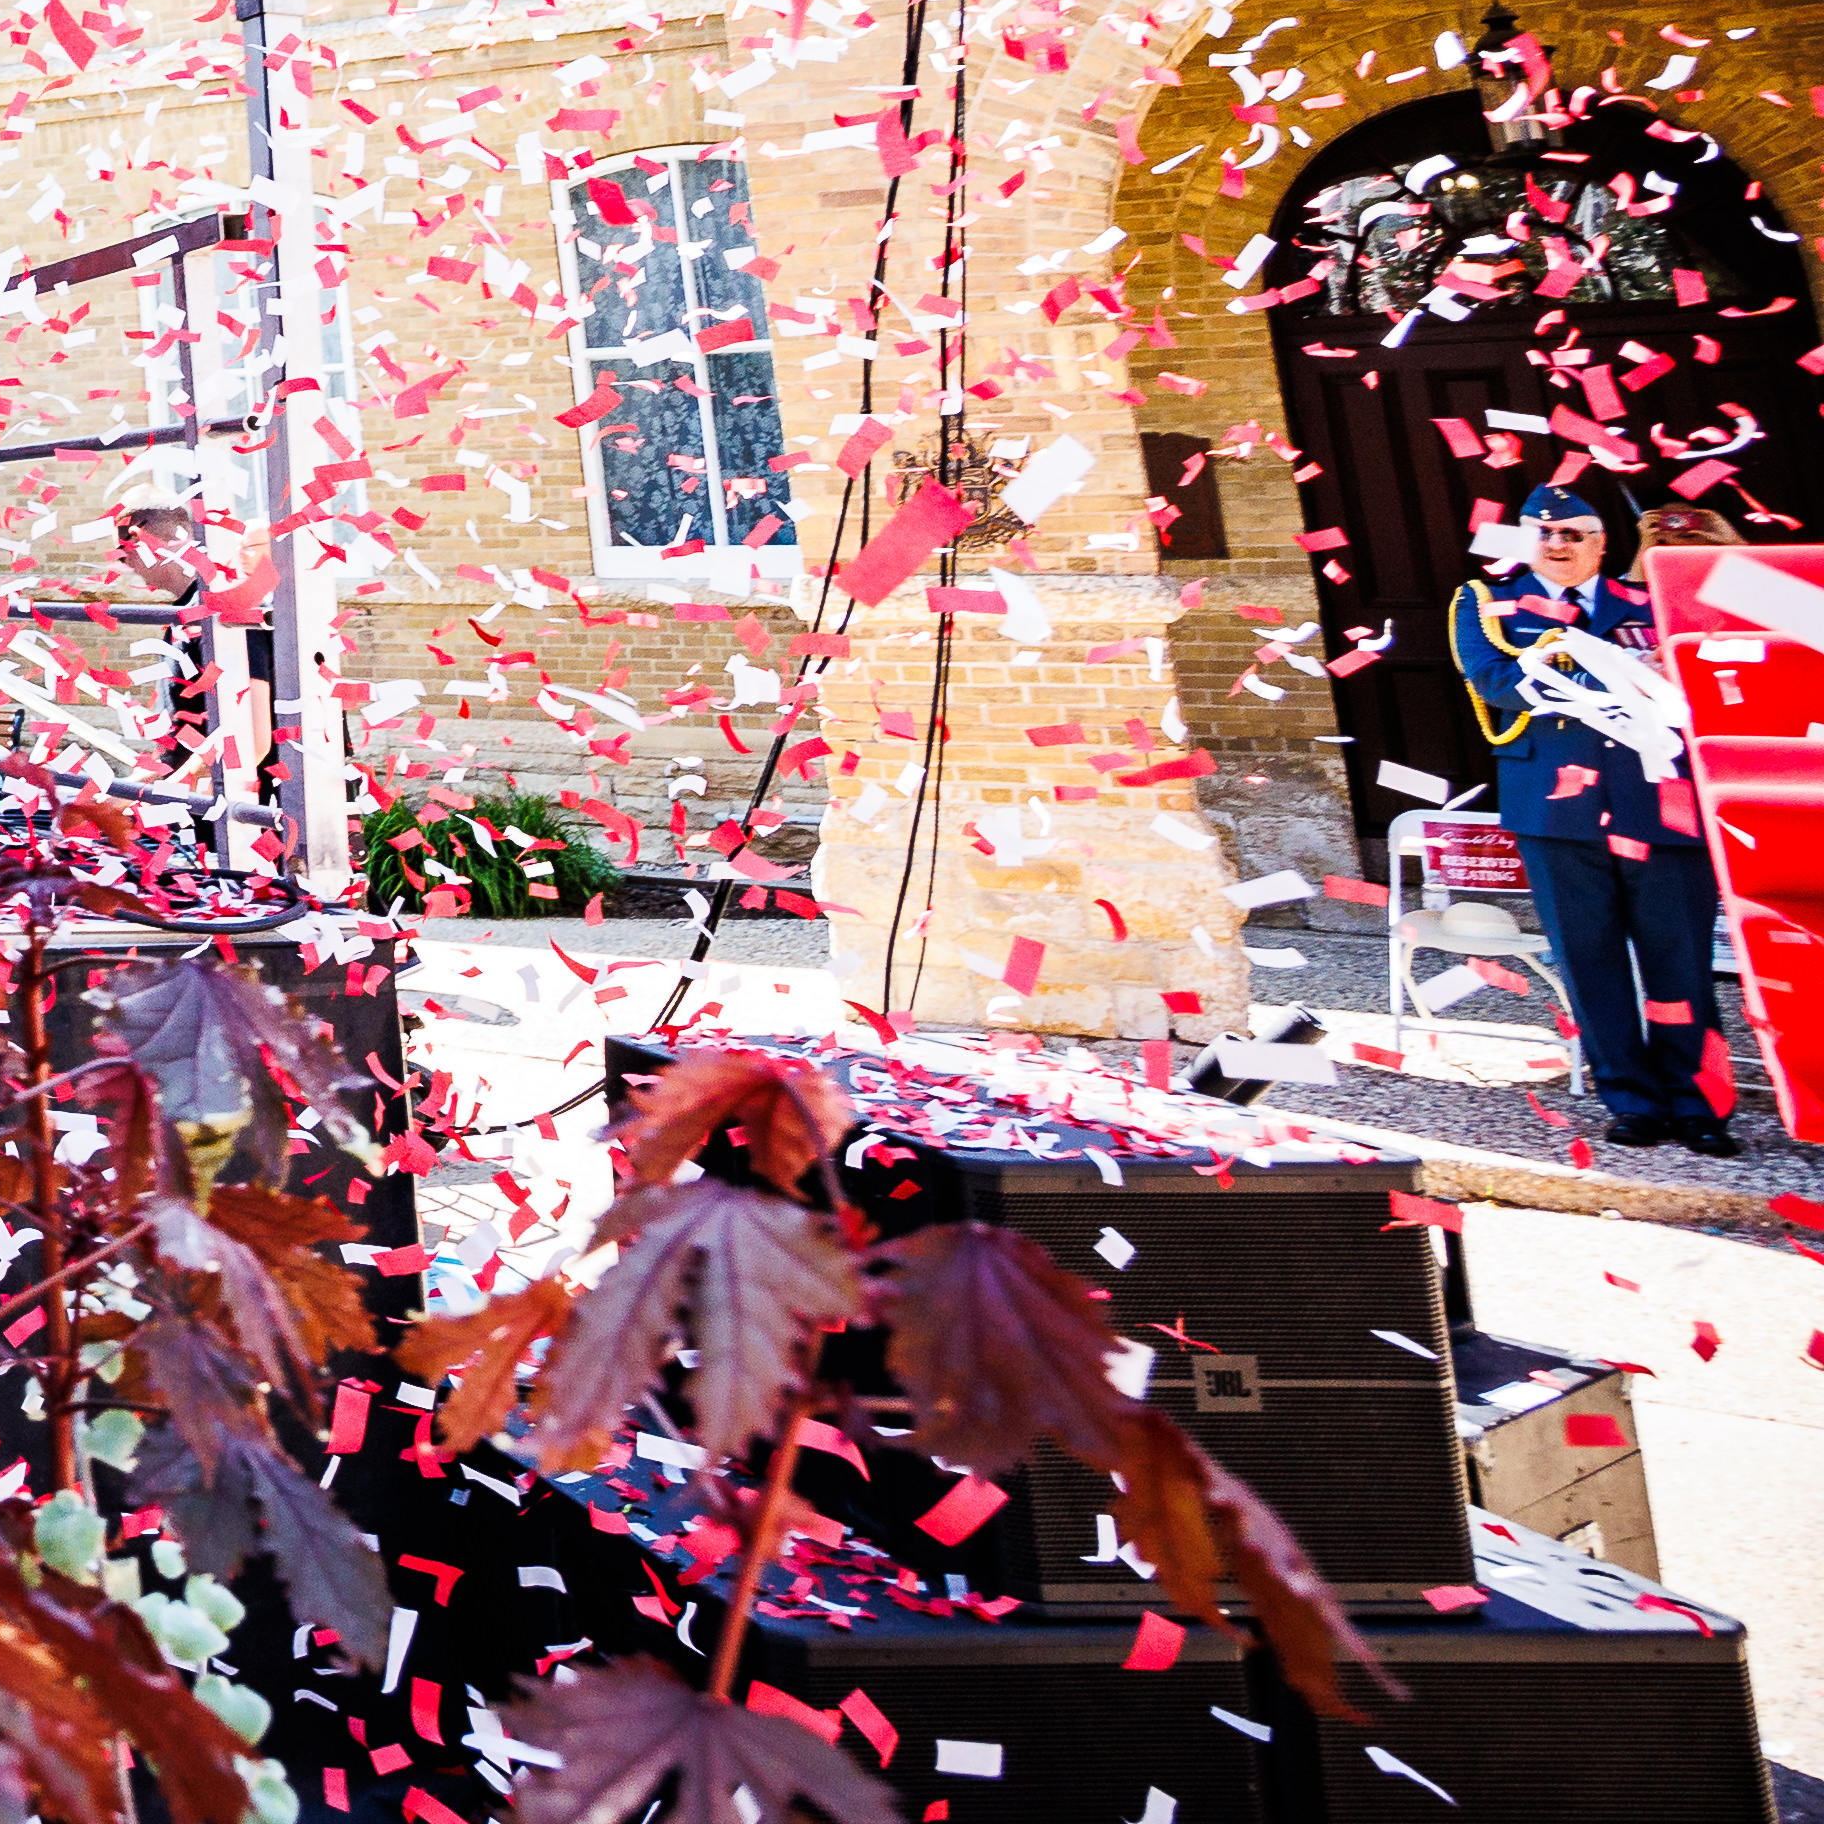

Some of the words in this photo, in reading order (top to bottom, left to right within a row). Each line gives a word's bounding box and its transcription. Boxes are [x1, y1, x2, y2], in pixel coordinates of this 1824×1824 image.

[1439, 854, 1521, 869] RESERVED
[1447, 868, 1517, 882] SEATING
[1203, 1369, 1252, 1398] JBL
